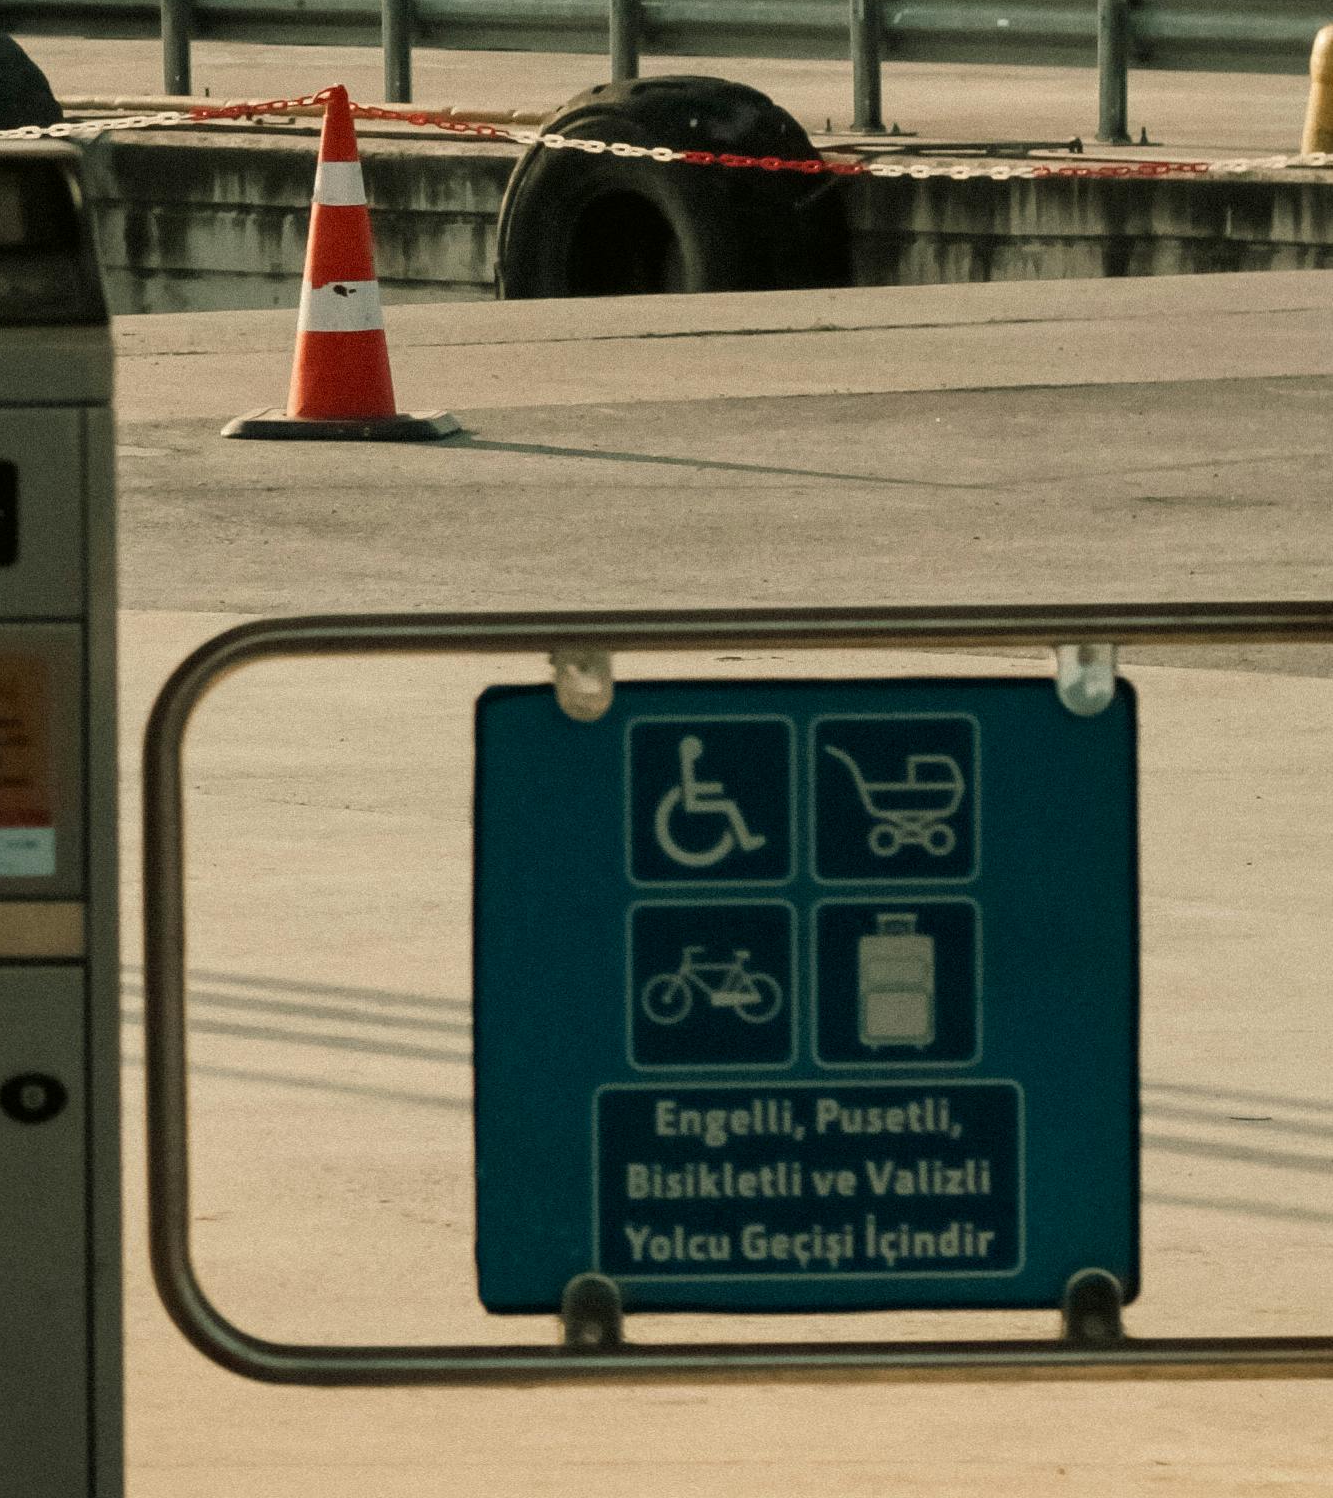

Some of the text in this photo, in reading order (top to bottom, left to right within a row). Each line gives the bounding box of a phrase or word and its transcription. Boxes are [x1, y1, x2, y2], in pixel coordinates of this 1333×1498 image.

[654, 1099, 963, 1147] Engelli, Pusetli,
[627, 1159, 991, 1199] Bisikletli ve Valizli
[626, 1214, 995, 1269] Yolcu Geçişi İçindir
